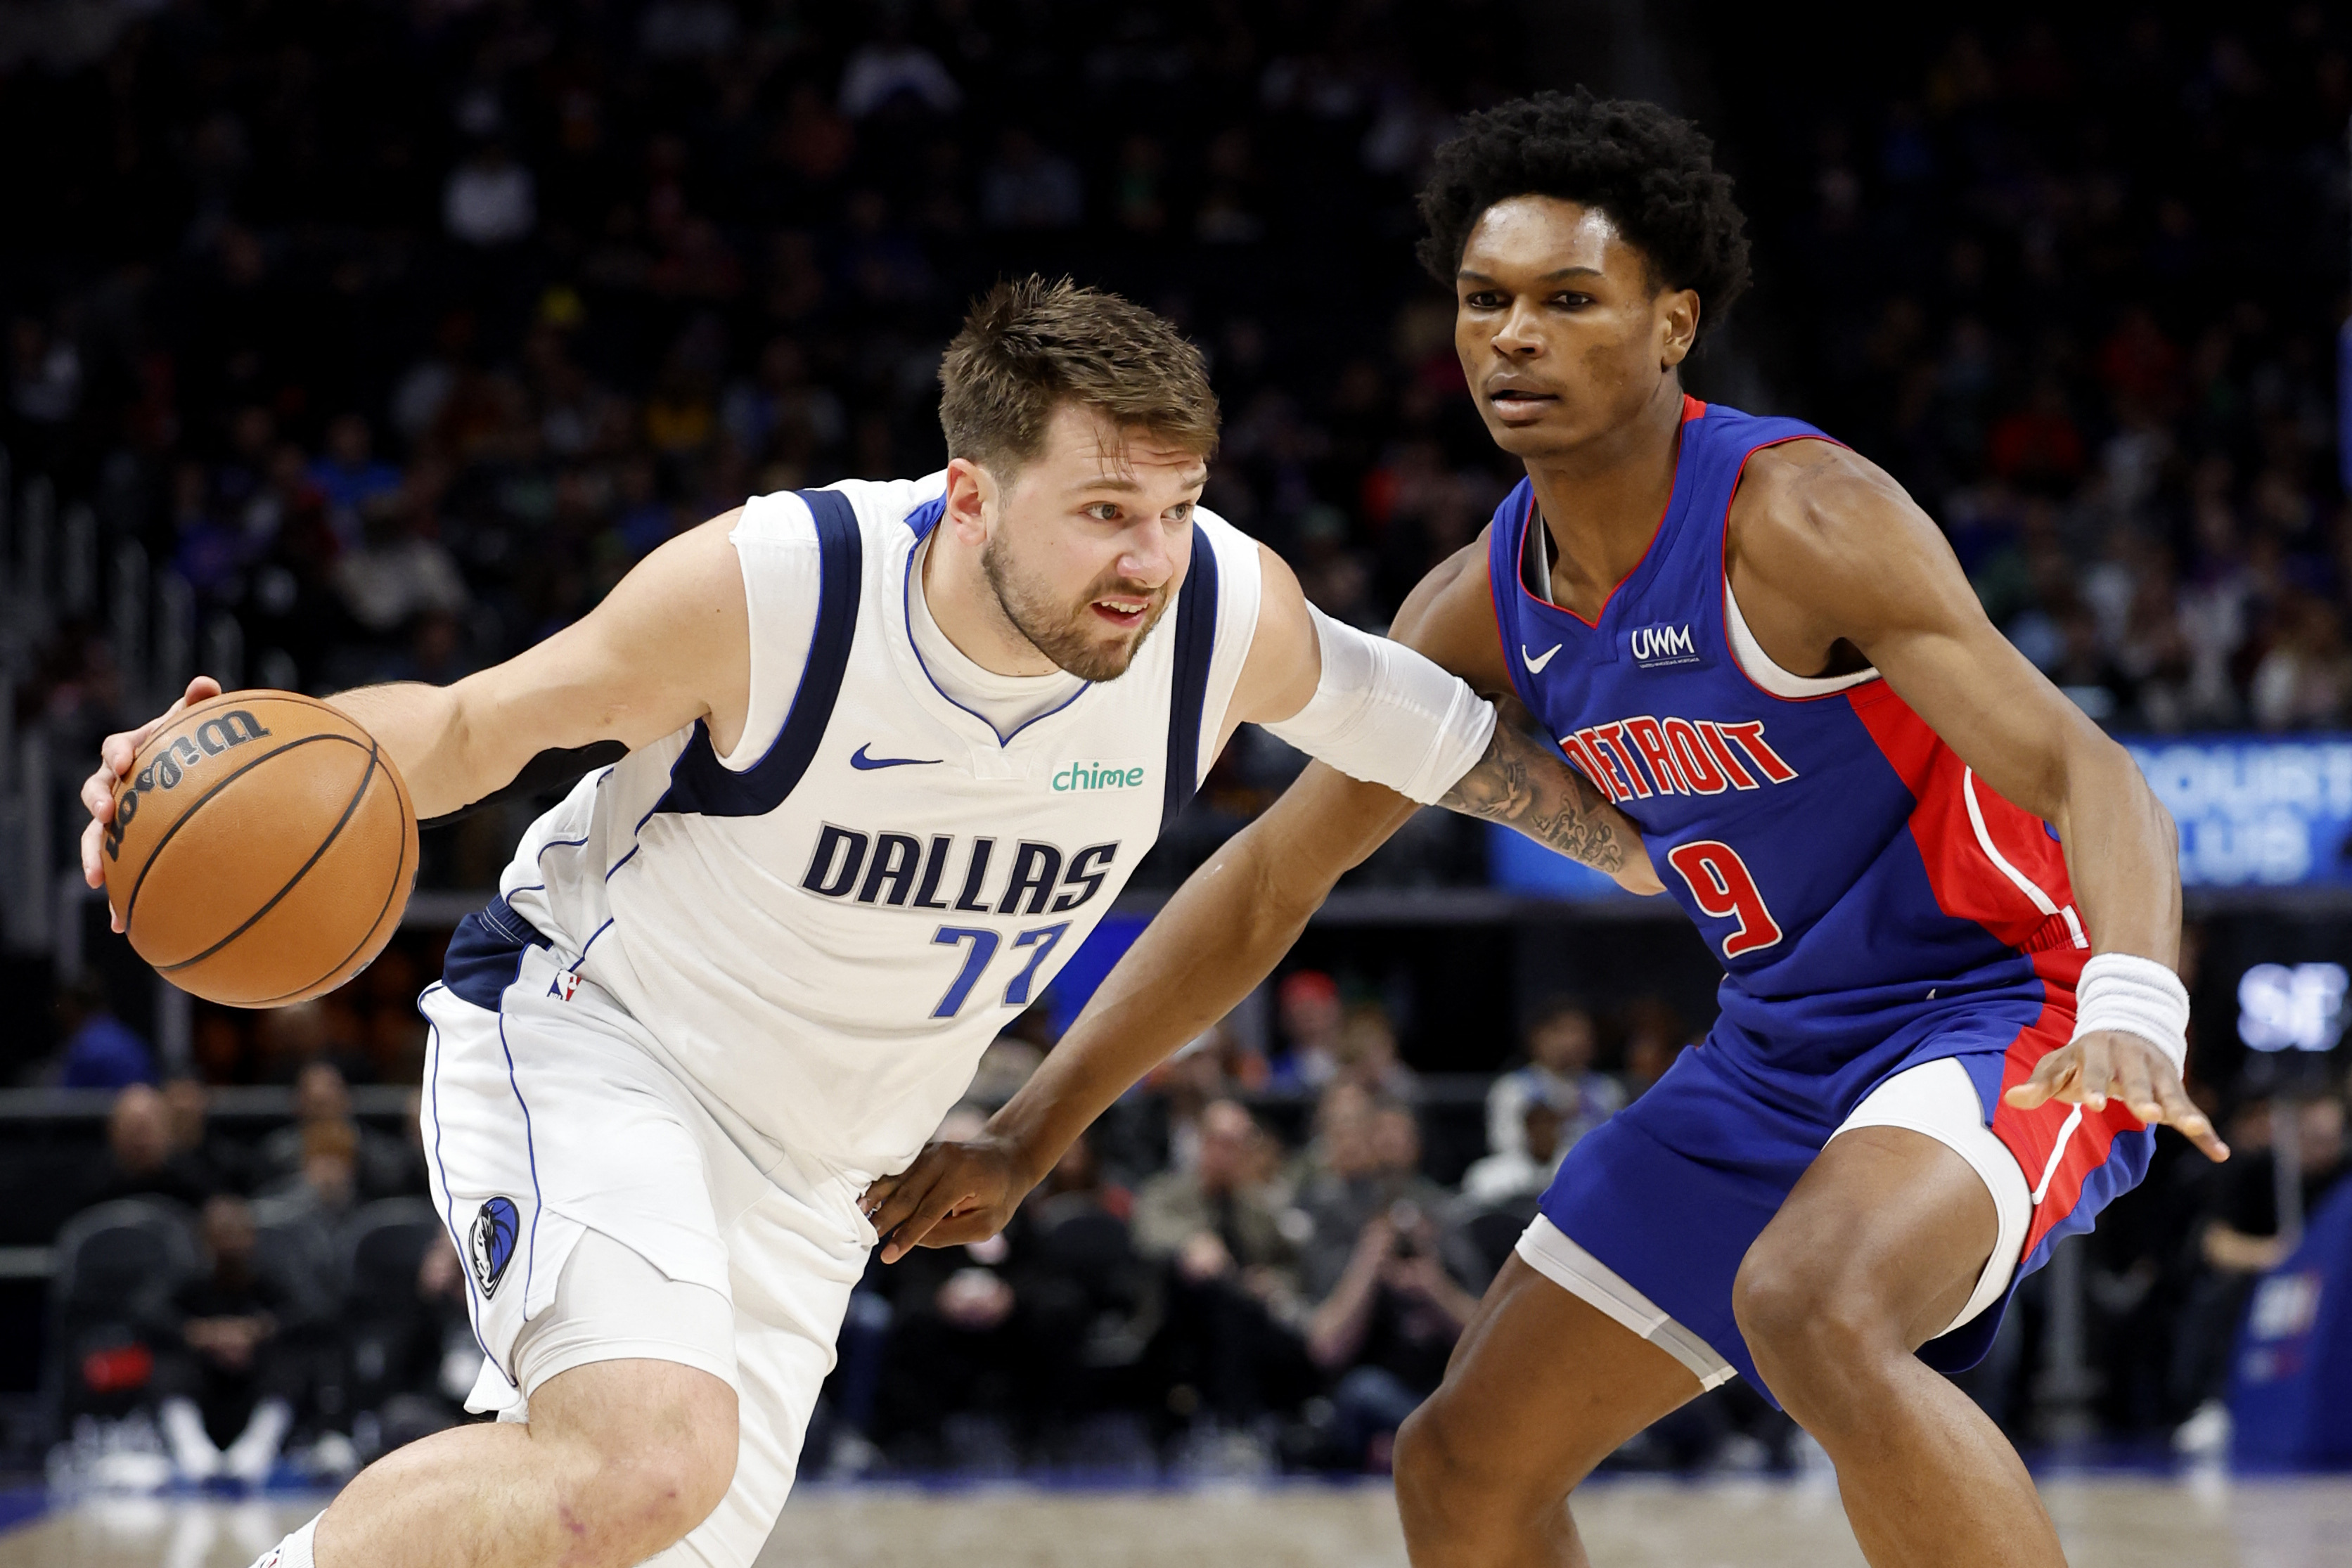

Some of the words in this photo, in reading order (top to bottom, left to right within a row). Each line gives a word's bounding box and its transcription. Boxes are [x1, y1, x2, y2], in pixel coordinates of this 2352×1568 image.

[1632, 624, 1695, 660] UWM
[105, 709, 270, 862] Wilson
[1052, 761, 1144, 791] chime
[1559, 715, 1799, 804] DETROIT
[797, 821, 1122, 915] DALLAS
[1667, 840, 1783, 959] 9
[928, 920, 1074, 1020] 77
